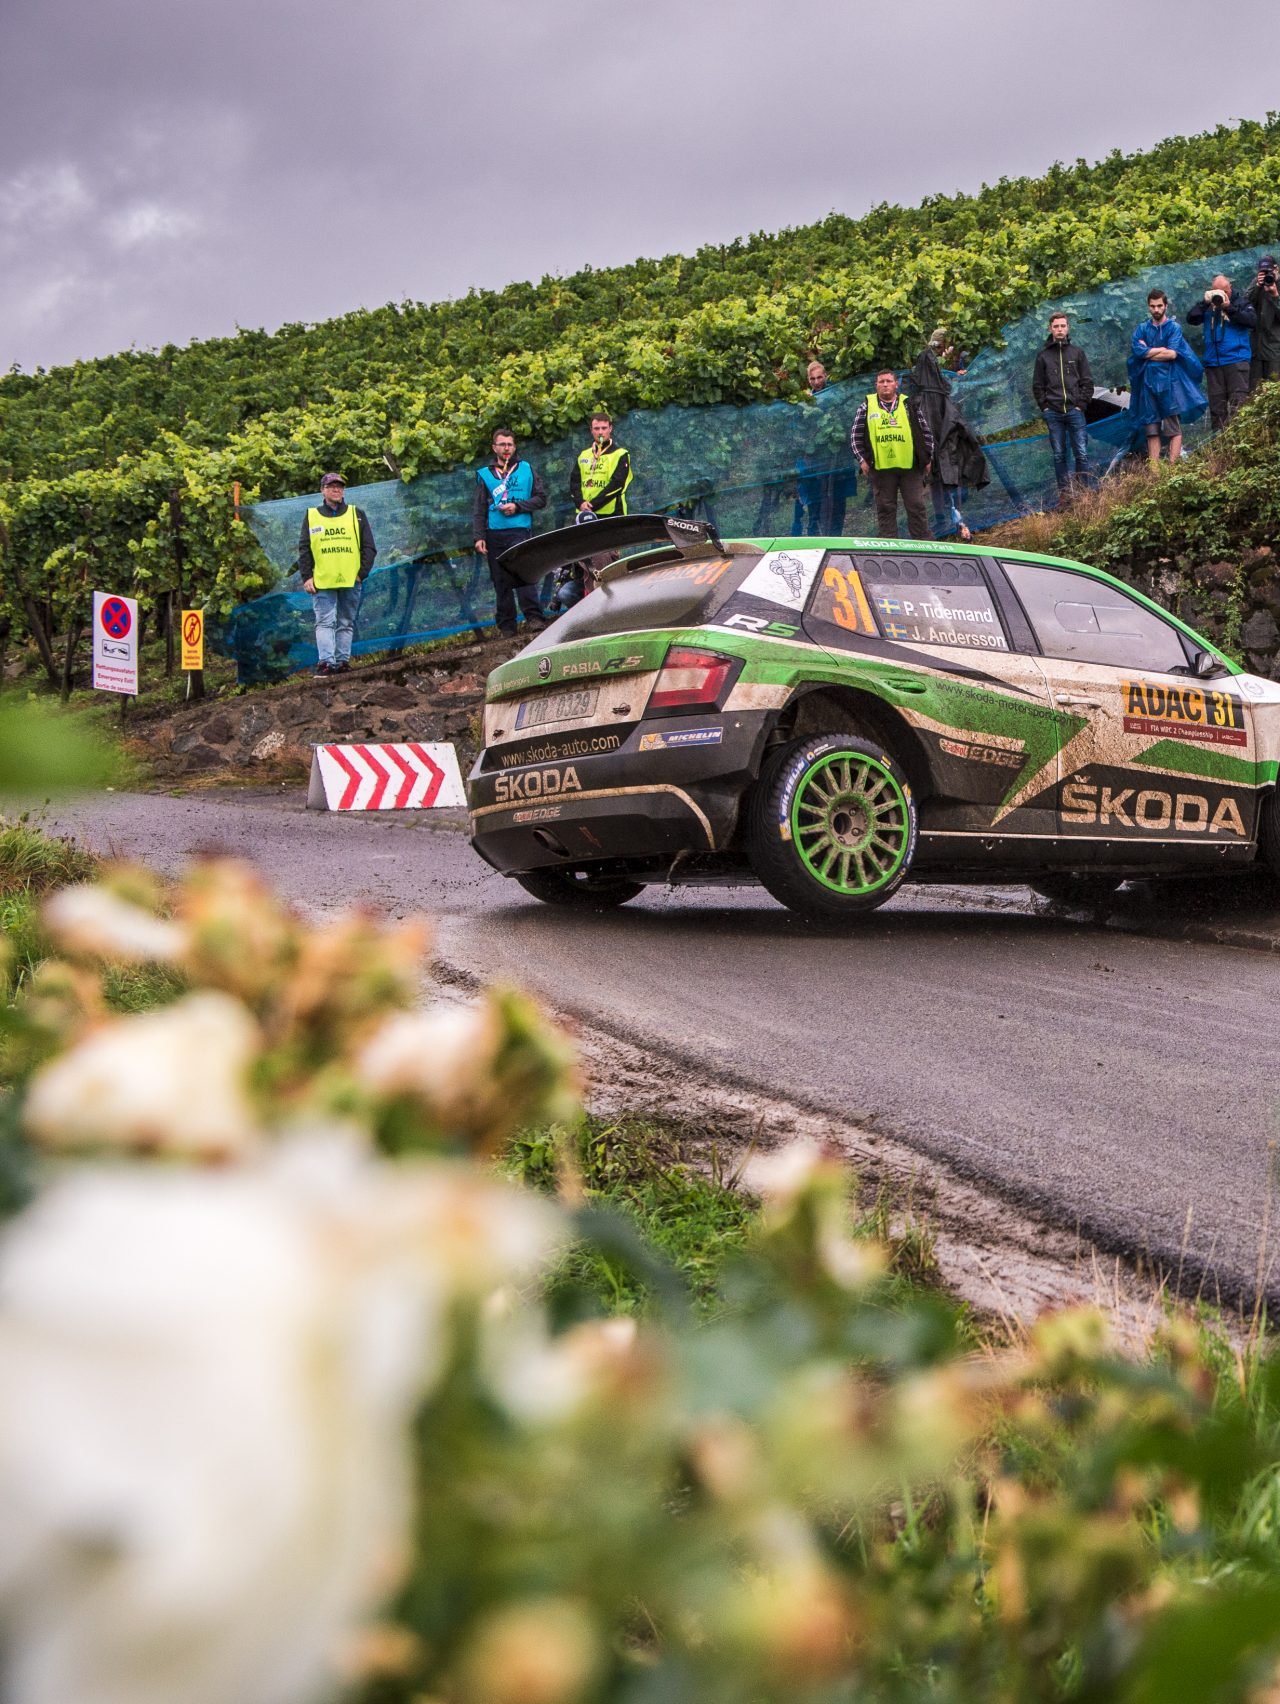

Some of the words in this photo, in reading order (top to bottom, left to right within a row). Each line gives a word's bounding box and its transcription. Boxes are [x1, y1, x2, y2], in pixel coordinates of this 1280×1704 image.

[325, 528, 346, 536] ADAC
[900, 541, 933, 550] Genuine
[934, 543, 954, 551] Parts
[824, 567, 878, 635] 31
[903, 601, 918, 617] P.
[920, 602, 993, 623] Tidemand
[723, 613, 801, 638] R5
[912, 625, 925, 641] J.
[929, 627, 1006, 648] Andersson
[562, 661, 601, 676] FABIA
[604, 655, 644, 671] R5
[1128, 682, 1202, 721] ADAC
[1211, 691, 1235, 727] 31
[669, 732, 721, 742] MICHELIN
[1150, 724, 1160, 732] FIA
[1178, 727, 1213, 740] Championship
[501, 734, 621, 767] www.skoda-auto.com
[495, 766, 582, 802] ŠKODA
[532, 806, 561, 820] EDGE
[1061, 775, 1247, 836] ŠKODA
